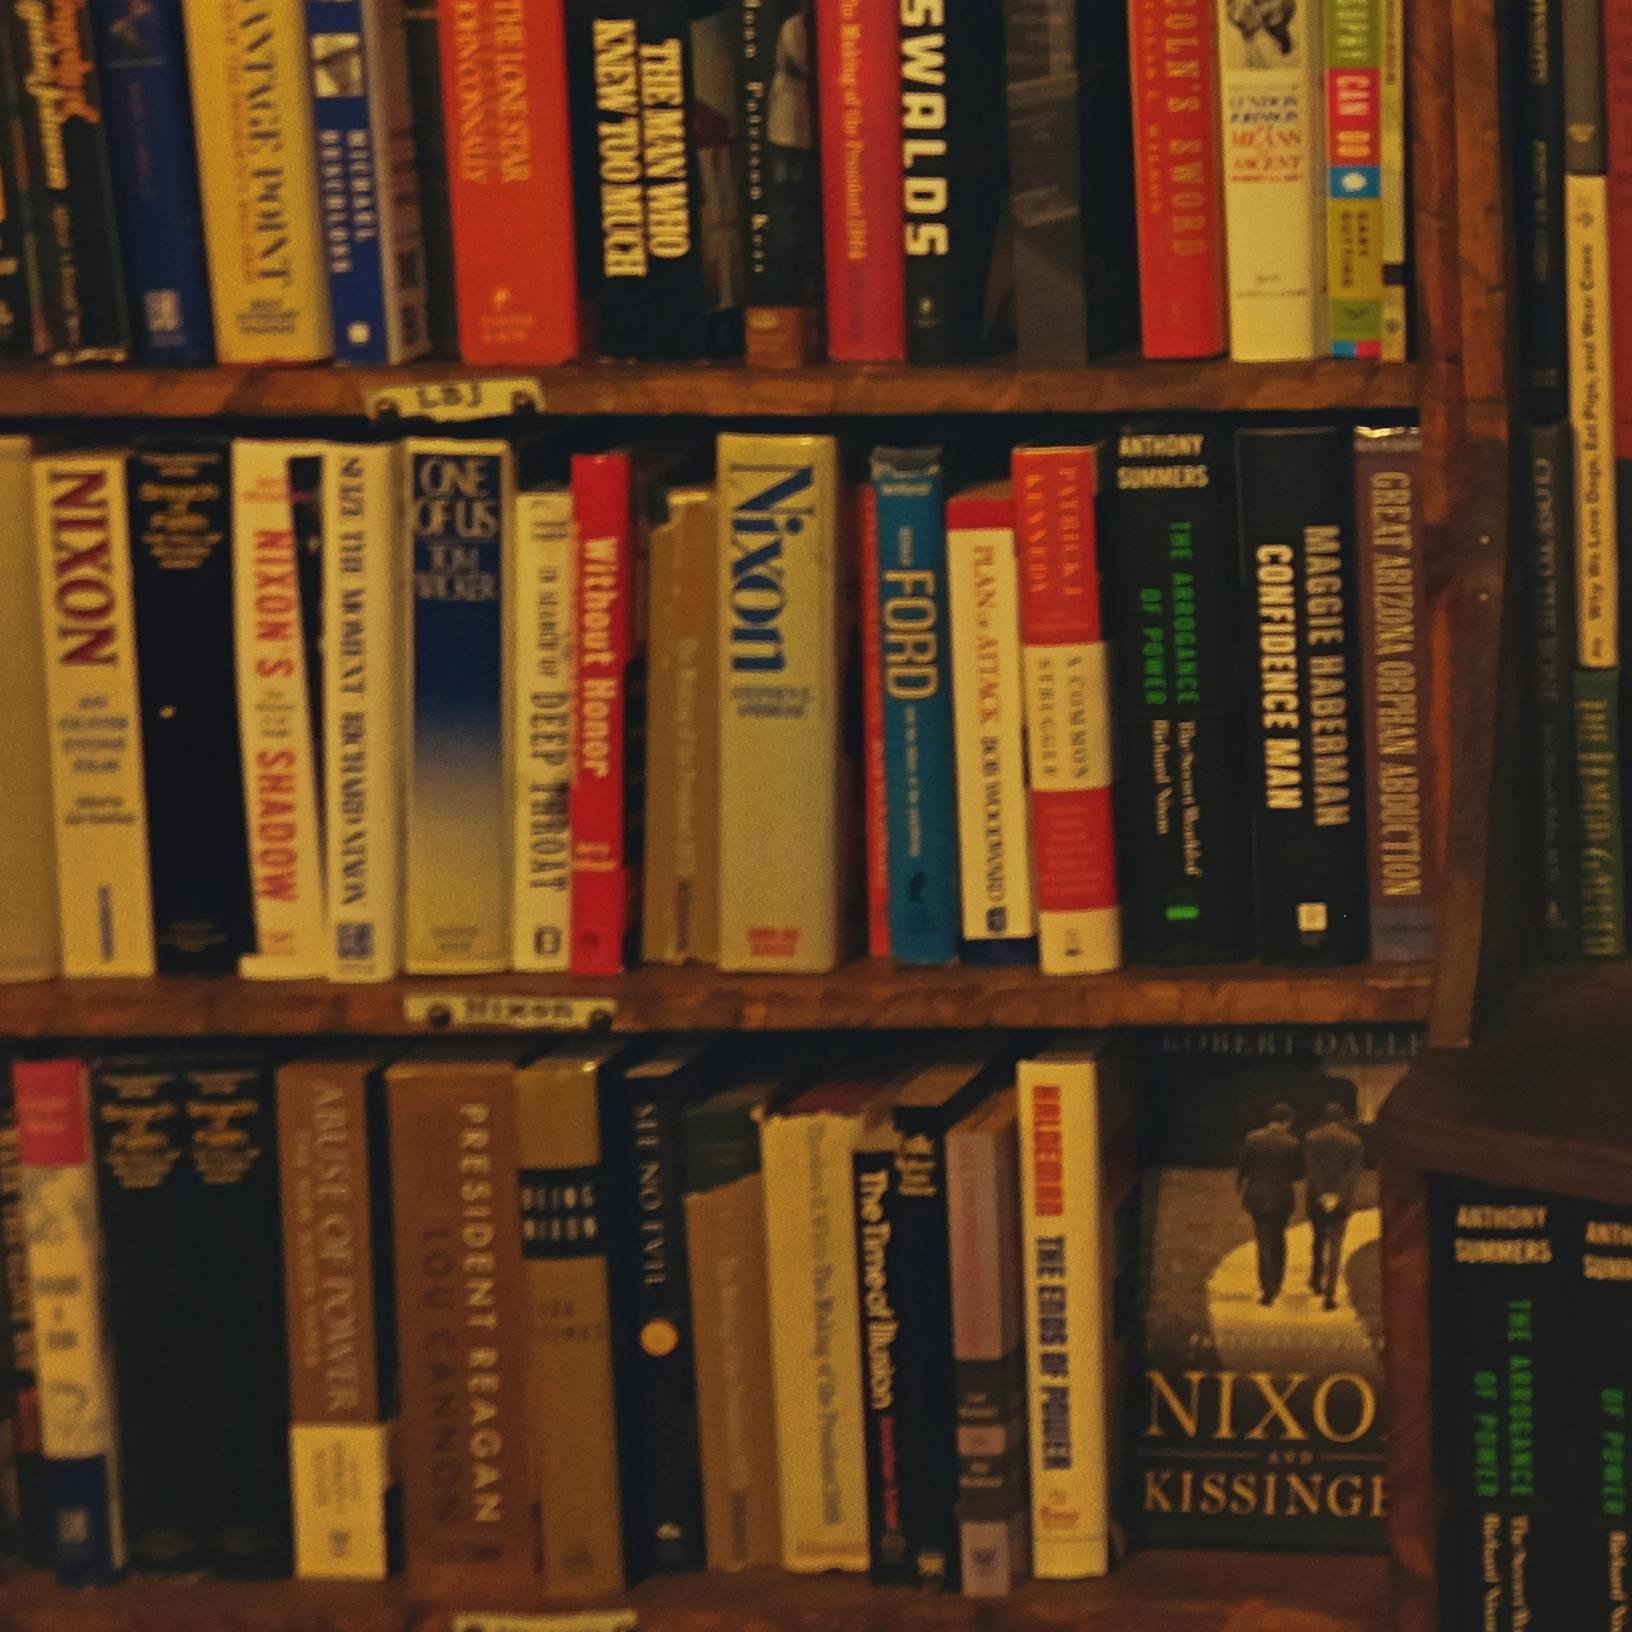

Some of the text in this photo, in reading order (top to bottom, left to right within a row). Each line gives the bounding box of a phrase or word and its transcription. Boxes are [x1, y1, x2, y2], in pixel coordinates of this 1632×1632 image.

[593, 19, 647, 276] KNEW TOO MUCH
[641, 38, 691, 258] THE MAN WHO
[1336, 75, 1369, 118] CAN
[1338, 130, 1369, 159] DO
[254, 163, 293, 286] POINT
[1168, 136, 1203, 259] SWORD
[417, 382, 484, 410] LBJ
[1119, 435, 1204, 458] ANTHONY
[417, 455, 488, 497] ONE
[1117, 465, 1208, 489] SUMMERS
[51, 471, 118, 665] NIXON
[730, 463, 816, 673] Nixon
[1168, 521, 1200, 705] THE ARROGANCE
[579, 537, 618, 778] Without Honor
[884, 571, 938, 699] FORD
[1140, 588, 1169, 706] OF POWER
[1256, 543, 1302, 810] CONFIDENCE MAN
[1304, 524, 1350, 826] MAGGIE HABERMAN
[1370, 471, 1421, 895] GREAT ARIZONA ORPHAN ABDUCTION
[254, 529, 297, 901] NIXON'S SHADOW
[528, 692, 569, 892] DEEP THROAT
[466, 1000, 574, 1022] Nixon
[1161, 1030, 1293, 1056] ROBERT
[311, 1080, 361, 1411] ABUSE OF POWER
[1034, 1085, 1072, 1470] HALDEMAN THE ENDS OF POWER
[1454, 1238, 1552, 1263] SUMMERS
[1456, 1206, 1548, 1229] ANTHONY
[459, 1102, 502, 1523] PRESIDENT REAGAN
[1147, 1371, 1377, 1441] NIXO
[1268, 1449, 1313, 1466] AND
[1474, 1371, 1499, 1498] OF POWER
[1507, 1299, 1534, 1497] THE ARROGANCE
